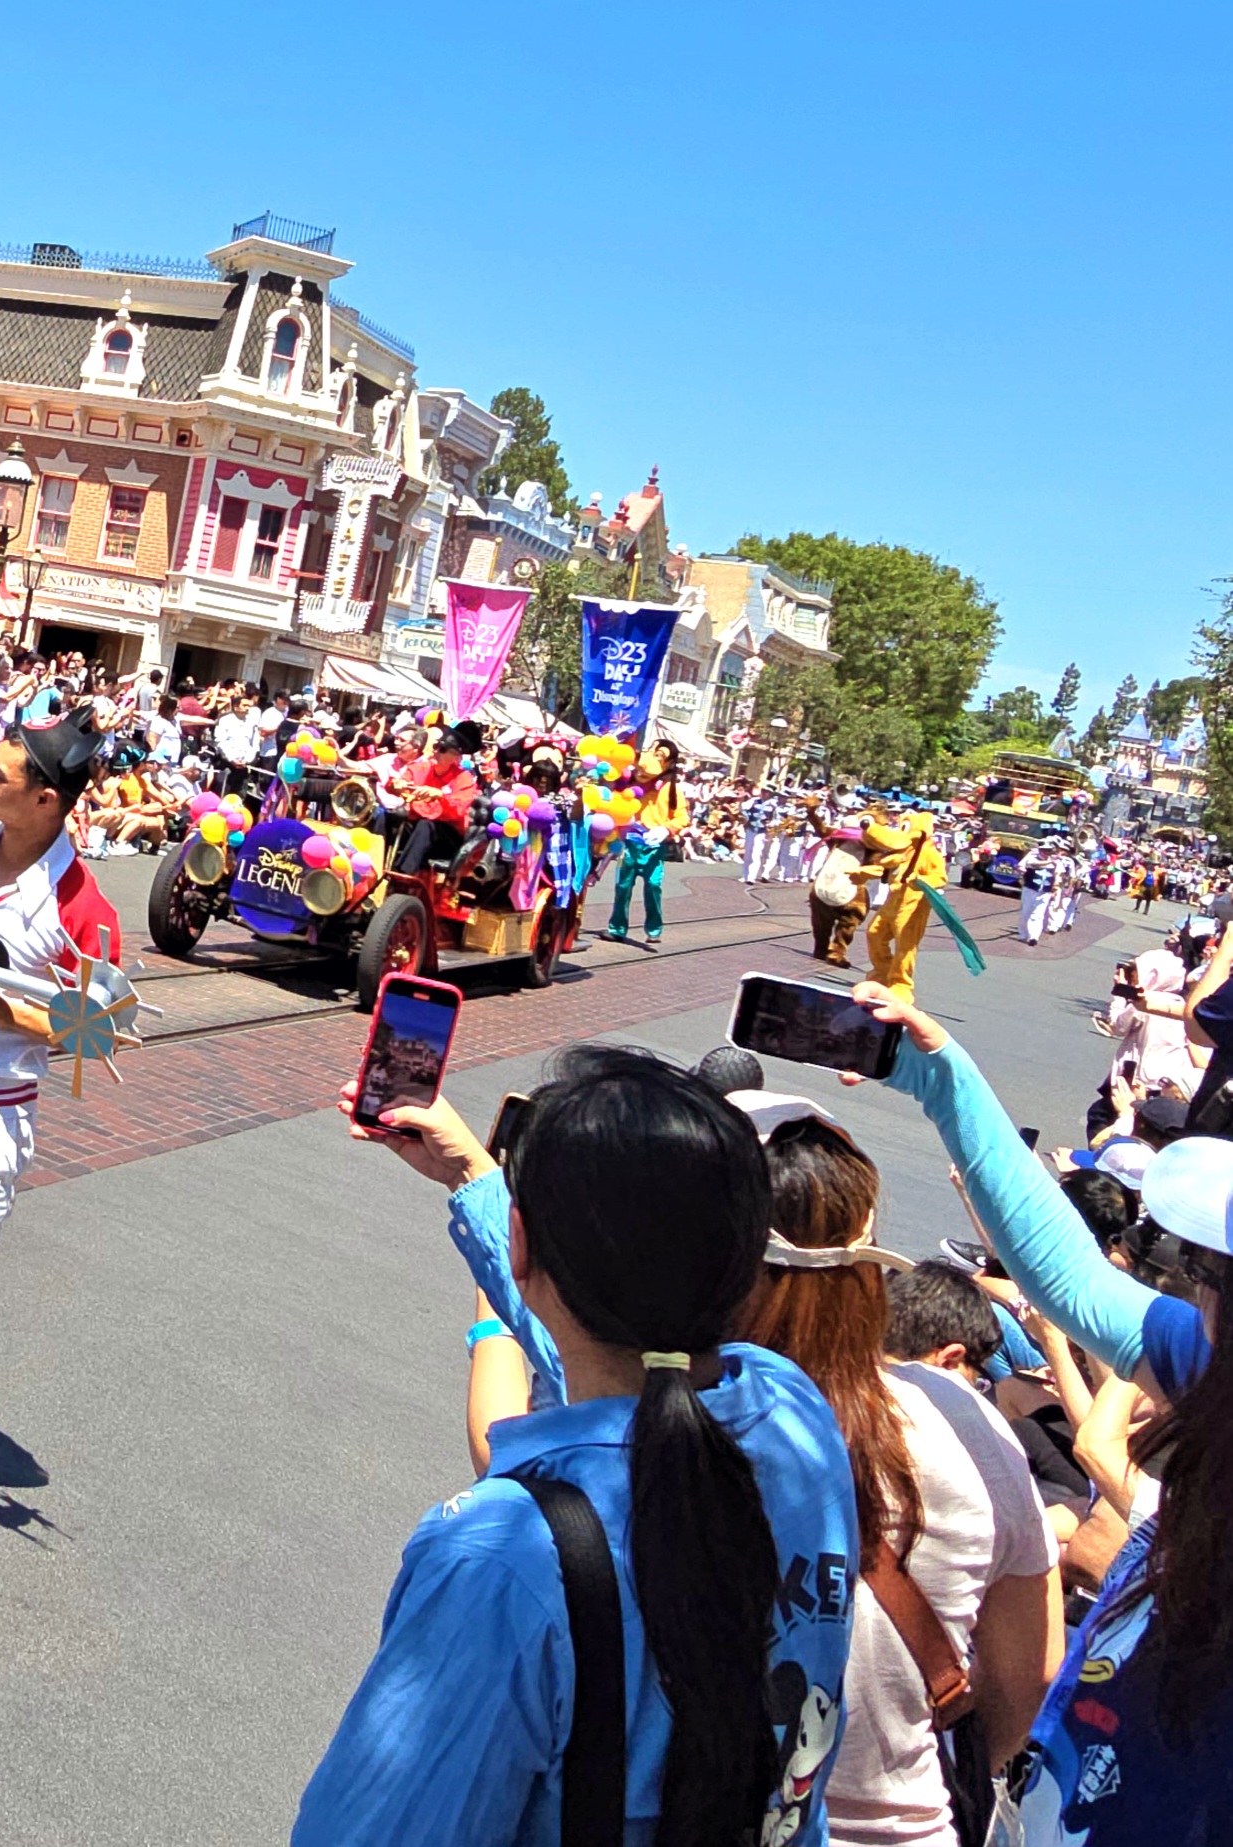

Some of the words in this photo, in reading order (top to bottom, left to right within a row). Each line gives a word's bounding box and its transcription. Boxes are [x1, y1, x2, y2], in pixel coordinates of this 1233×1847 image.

[458, 618, 499, 645] D23
[403, 637, 419, 649] ICE
[420, 638, 445, 654] CREA
[598, 636, 648, 663] D23
[604, 662, 642, 683] DAY
